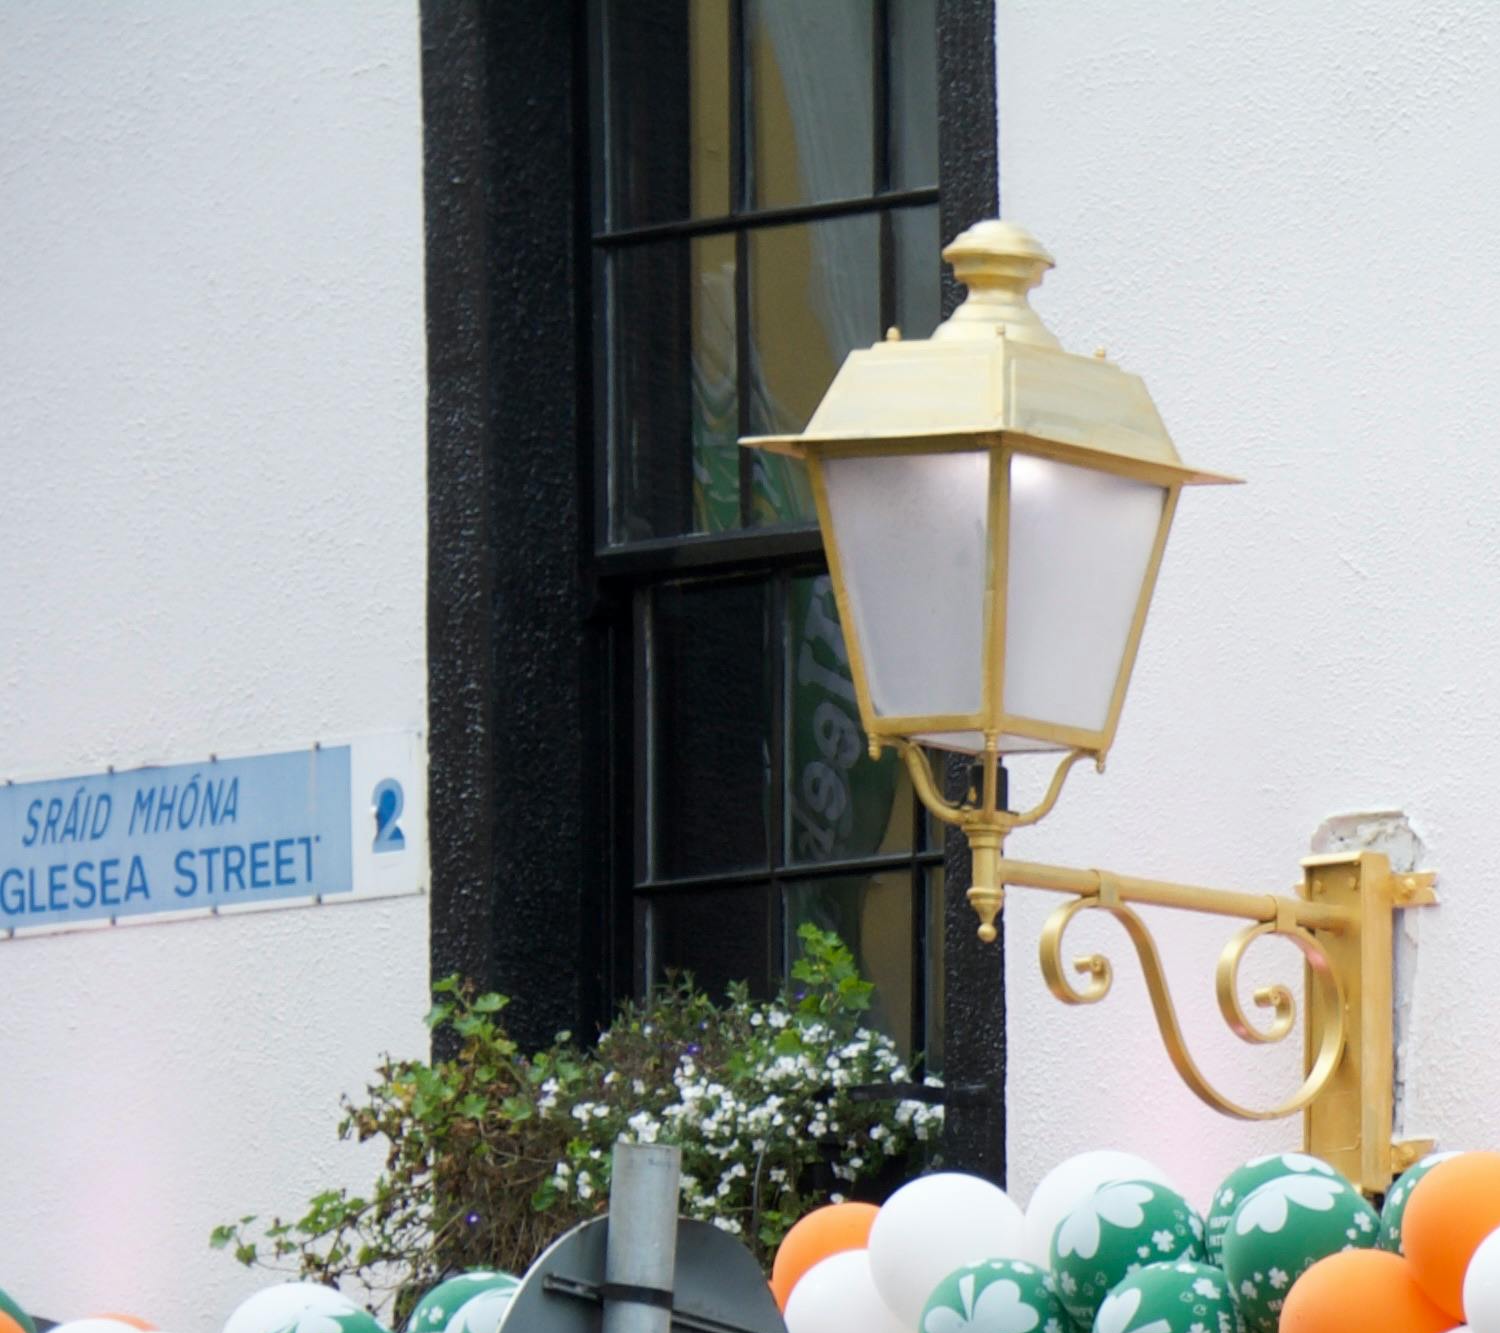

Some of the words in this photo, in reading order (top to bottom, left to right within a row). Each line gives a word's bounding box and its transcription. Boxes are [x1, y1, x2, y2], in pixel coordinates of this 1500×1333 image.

[22, 786, 113, 848] SRÁID
[127, 774, 240, 837] MHÓNA
[371, 777, 406, 854] 2
[0, 856, 151, 915] GLESEA
[174, 834, 321, 898] STREET
